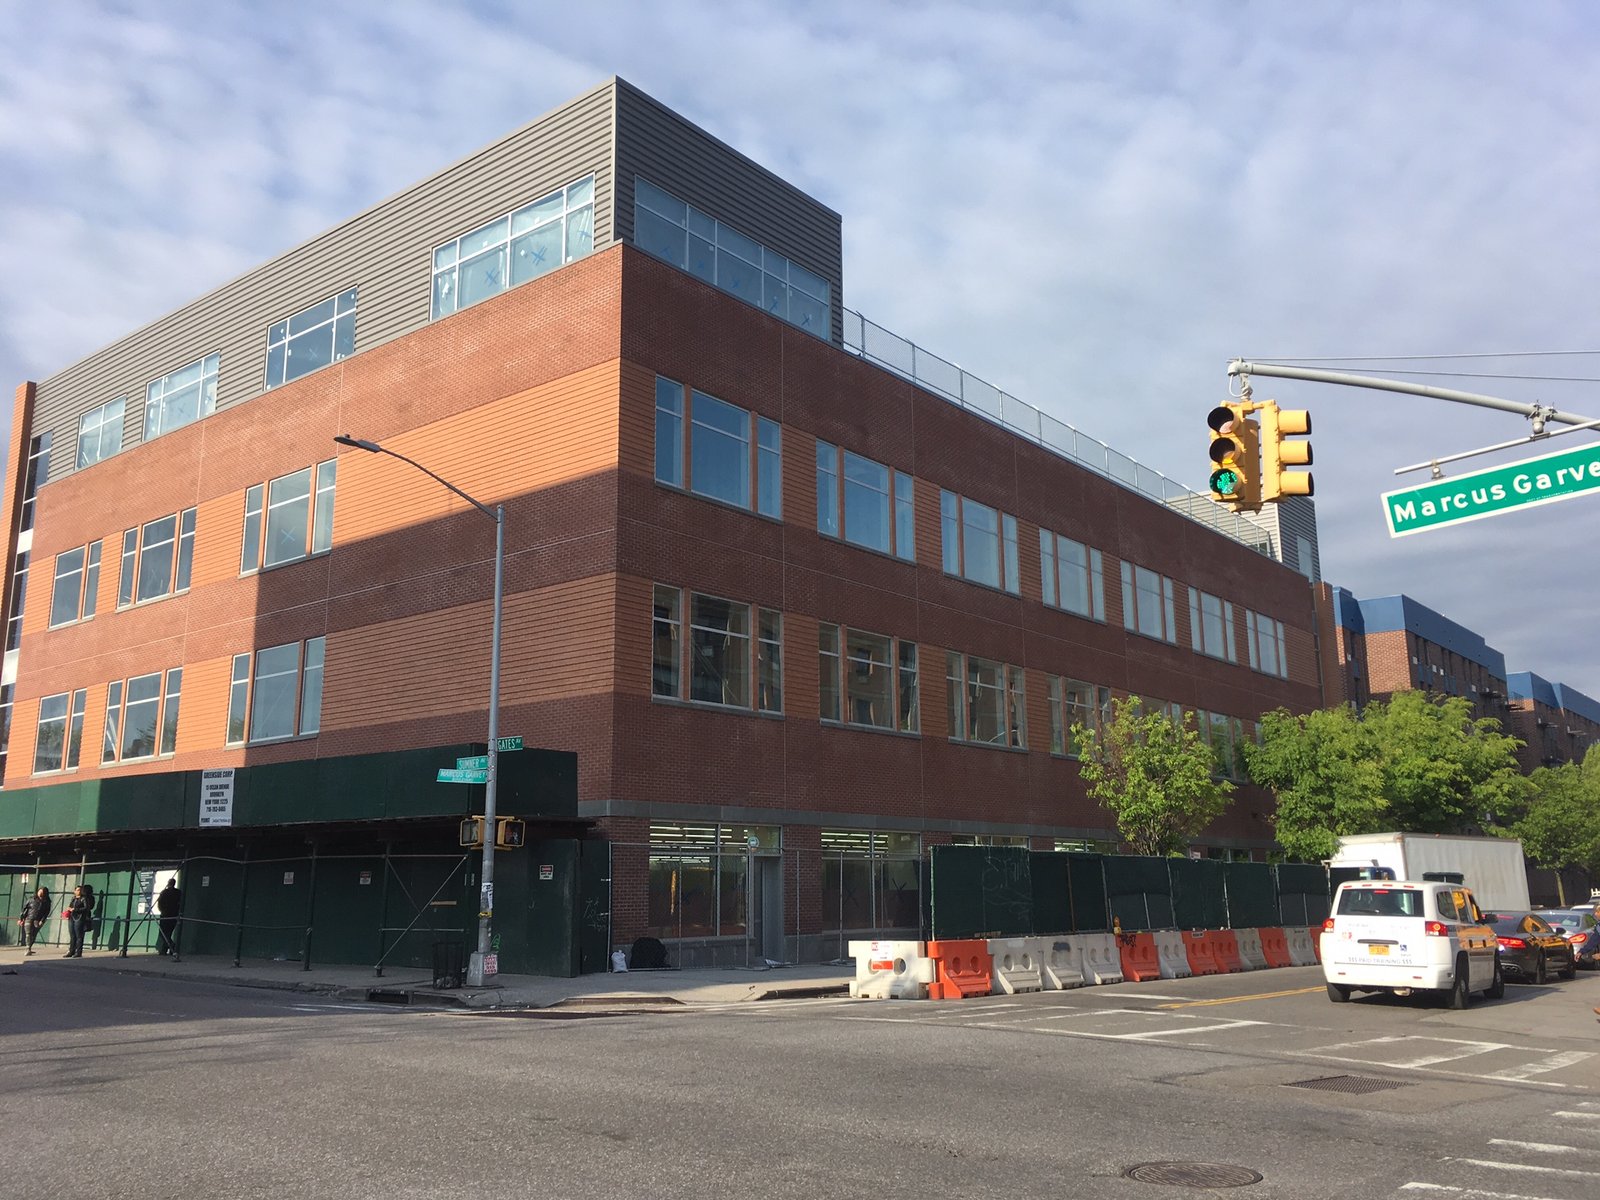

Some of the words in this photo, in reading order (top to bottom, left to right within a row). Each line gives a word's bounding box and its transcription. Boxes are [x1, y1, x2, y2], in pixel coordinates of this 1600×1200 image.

[1393, 484, 1507, 523] Marcus
[1513, 461, 1600, 494] Garve
[497, 738, 516, 750] GATES
[458, 758, 480, 770] SUMNER
[440, 770, 464, 778] MARCUS
[465, 771, 486, 779] GARVEY
